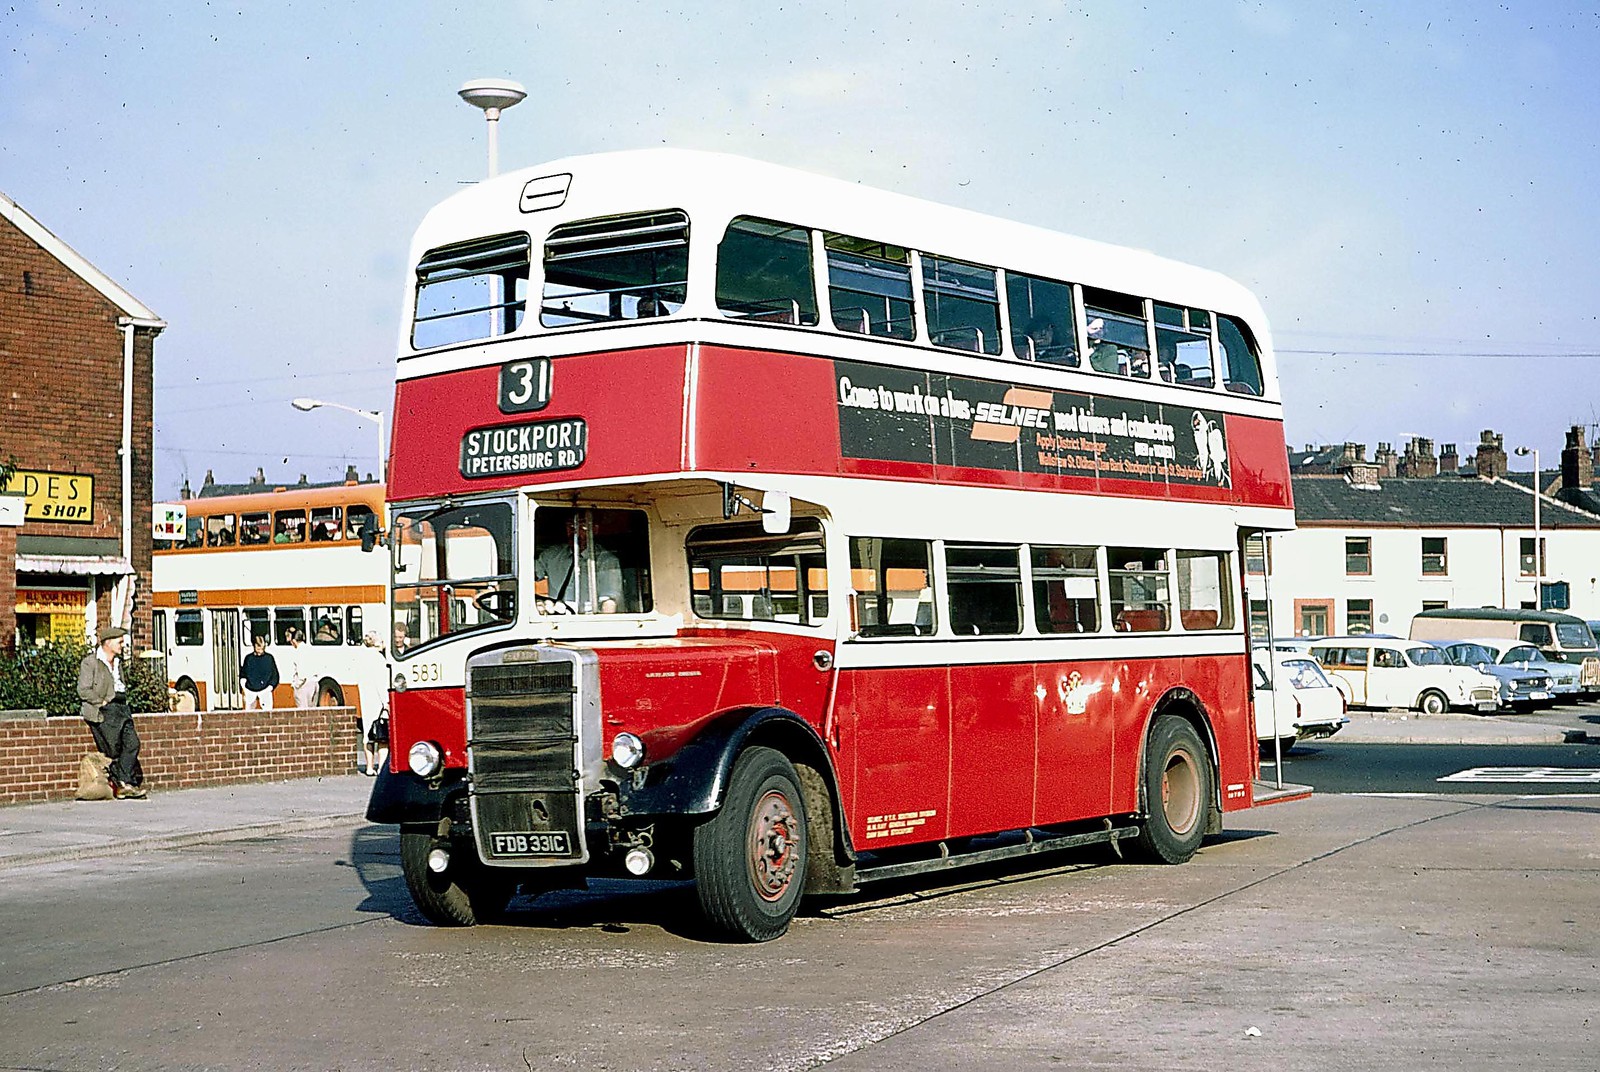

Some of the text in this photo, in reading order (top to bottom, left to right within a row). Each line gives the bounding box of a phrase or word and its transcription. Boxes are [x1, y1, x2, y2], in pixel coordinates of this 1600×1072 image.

[508, 360, 548, 405] 31
[839, 376, 879, 410] Come
[878, 385, 894, 412] to
[894, 385, 925, 415] work
[924, 394, 939, 416] on
[974, 402, 1050, 429] SELNEC
[1078, 407, 1110, 435] drivers
[1110, 412, 1128, 437] and
[1128, 415, 1175, 442] conductors
[467, 421, 584, 456] STOCKPORT
[1036, 432, 1107, 455] Apply District Manager
[467, 452, 553, 474] (PETERSBURG
[42, 504, 87, 518] SHOP
[412, 663, 443, 683] 5831
[495, 835, 565, 852] FDB 331C
